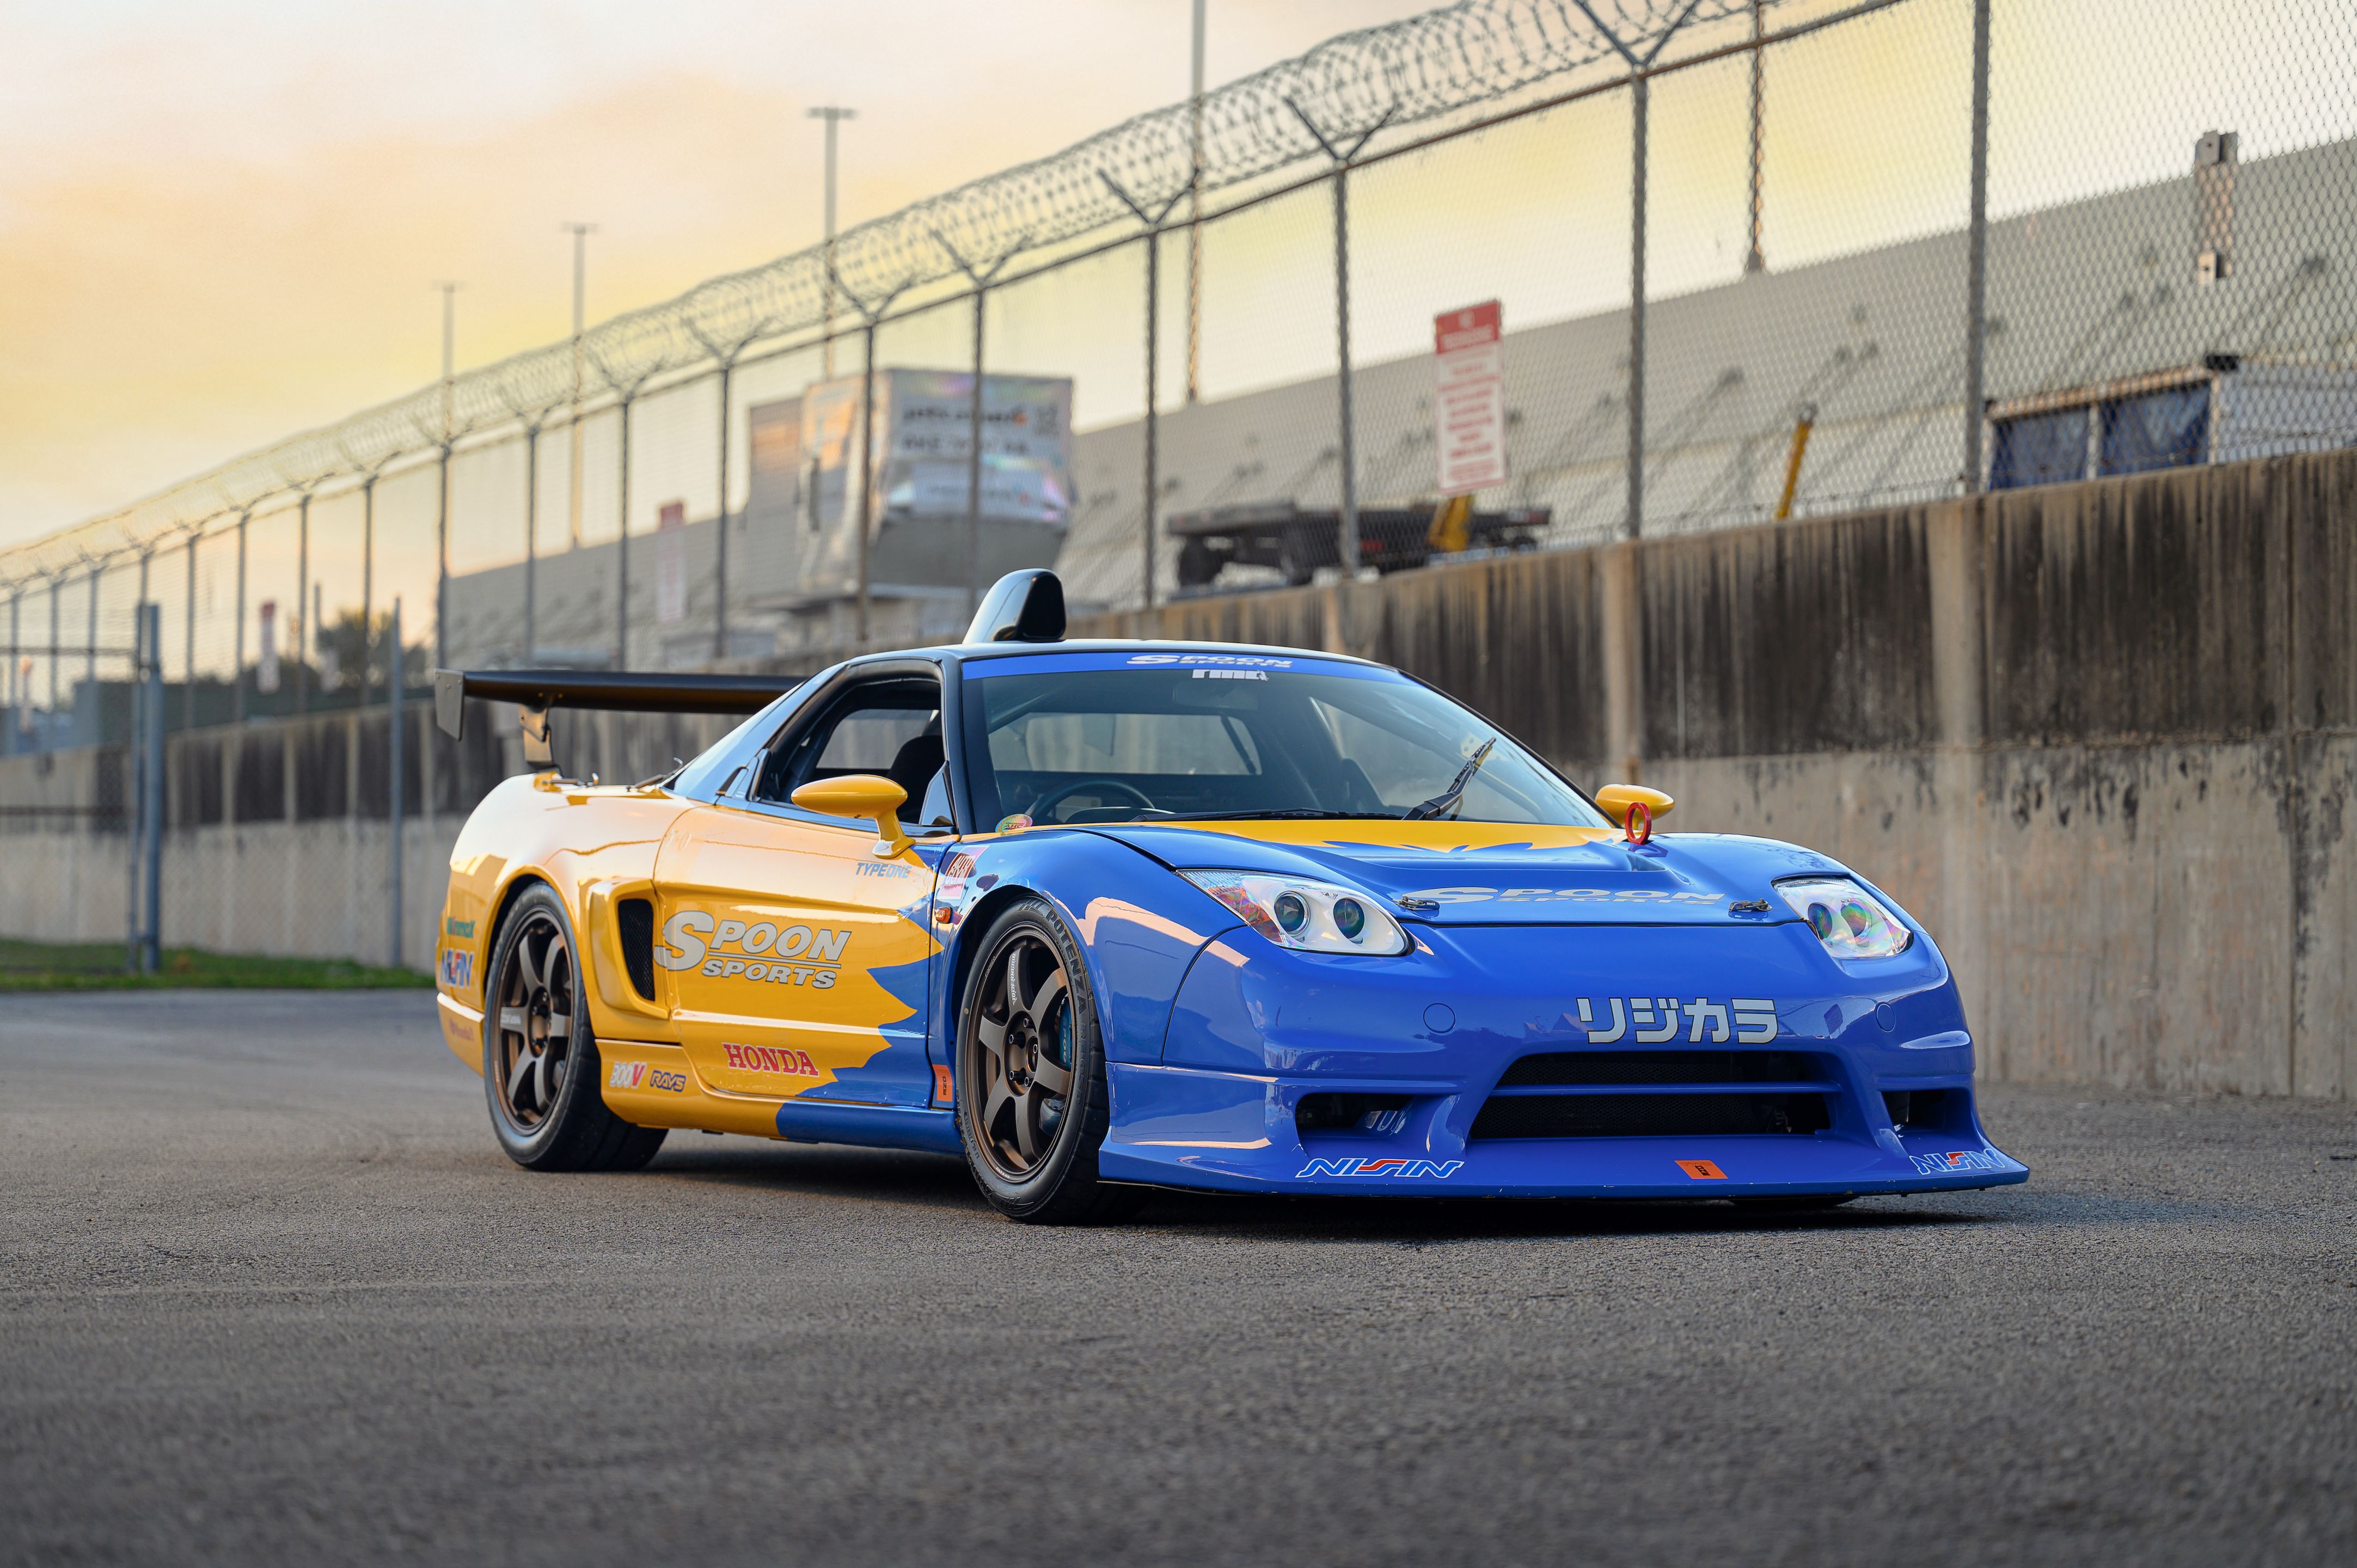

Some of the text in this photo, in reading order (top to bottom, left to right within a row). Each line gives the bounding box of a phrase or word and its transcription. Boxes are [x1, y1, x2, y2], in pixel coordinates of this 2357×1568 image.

[1126, 654, 1293, 665] SPOON
[1401, 886, 1727, 904] SPOON
[653, 910, 853, 971] SPOON
[701, 960, 837, 989] SPORTS
[1040, 909, 1087, 1015] POTENZA
[1576, 997, 1779, 1044] リジカラ
[722, 1042, 819, 1077] HONDA
[650, 1069, 687, 1092] RAYS
